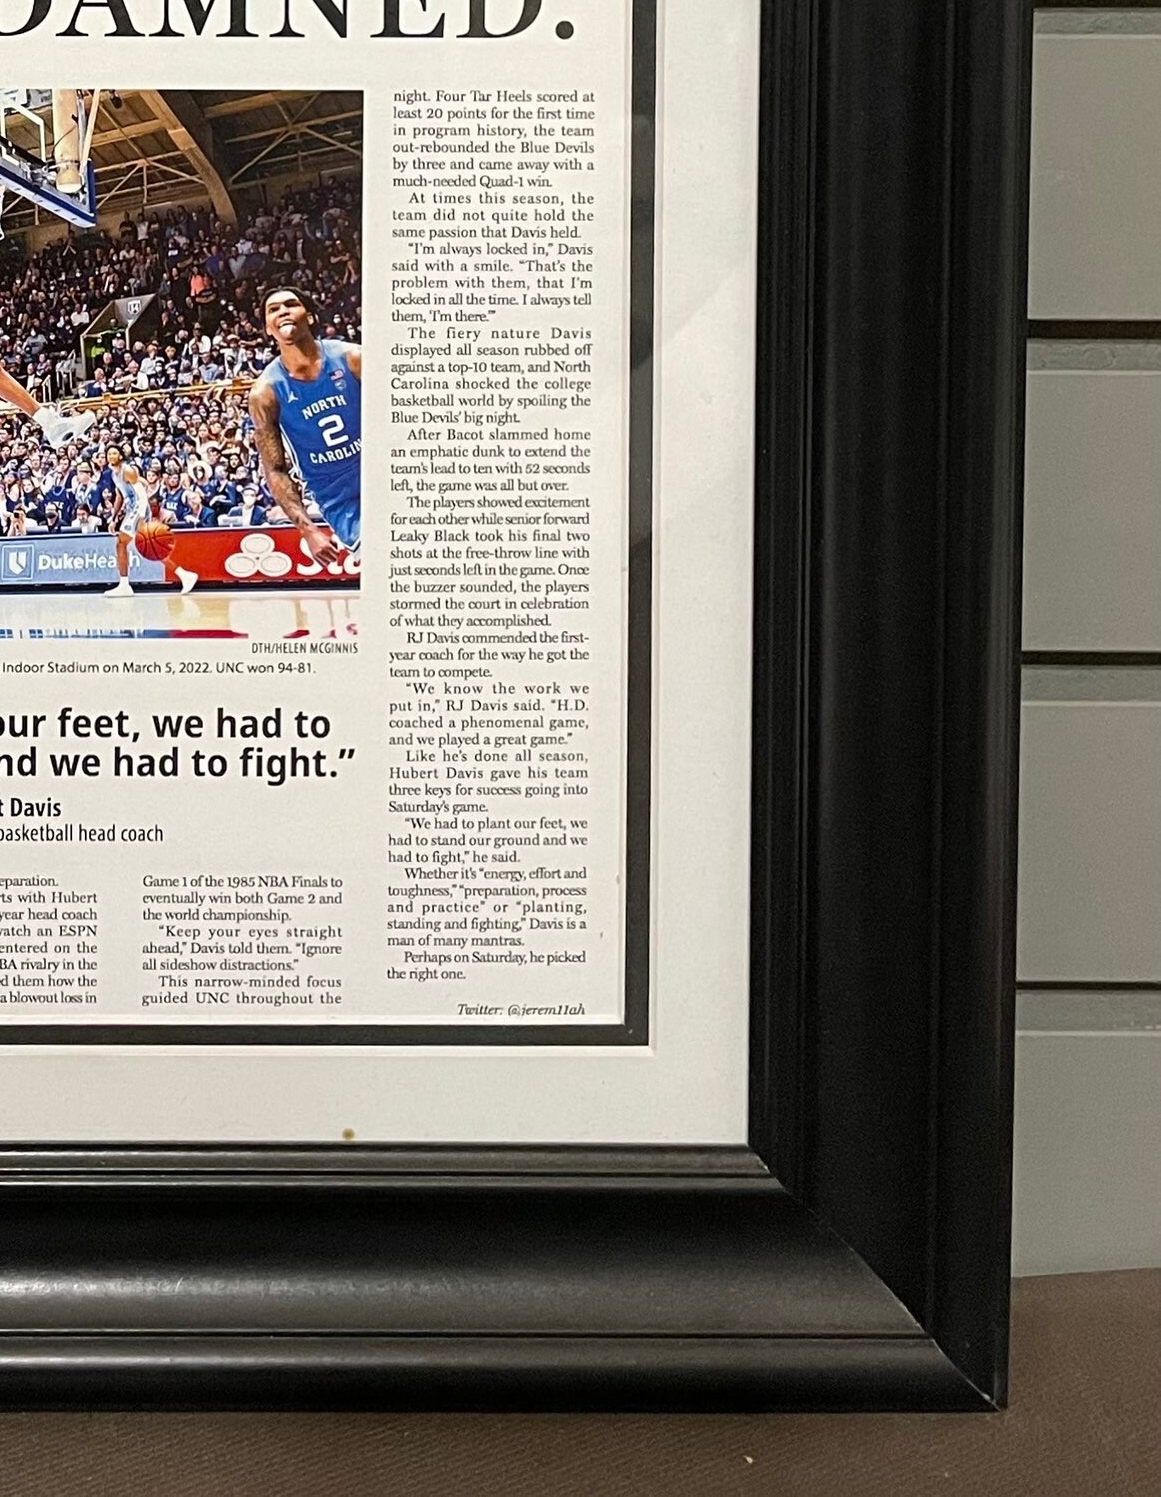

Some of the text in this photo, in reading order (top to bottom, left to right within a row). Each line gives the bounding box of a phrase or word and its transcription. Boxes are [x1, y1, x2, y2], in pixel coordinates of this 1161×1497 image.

[394, 123, 594, 139] in program history, the team
[408, 326, 591, 342] The fiery nature Davis
[391, 377, 591, 393] Carolina shocked the college
[302, 395, 347, 420] NORTH
[318, 414, 349, 447] 2
[391, 529, 590, 545] Leaky Black took his final two
[39, 550, 140, 571] DukeHeah
[252, 642, 358, 654] DTH/HELEN MCGINNIS
[2, 661, 45, 674] Indoor
[47, 661, 100, 674] Stadium
[103, 664, 119, 674] on
[123, 661, 162, 674] March
[165, 661, 176, 676] 5,
[179, 661, 213, 674] 2022.
[216, 661, 245, 674] UNC
[247, 664, 275, 674] won
[277, 661, 317, 674] 94-81.
[58, 708, 139, 742] feet,
[153, 716, 203, 737] we
[218, 708, 281, 738] had
[295, 712, 330, 738] to
[50, 755, 100, 776] we
[115, 747, 178, 776] had
[192, 751, 227, 776] to
[240, 747, 354, 786] fight.”
[389, 766, 588, 782] Hubert Davis gave his team
[11, 798, 61, 816] Davis
[79, 824, 115, 841] head
[121, 825, 163, 841] coach
[54, 945, 70, 954] on
[77, 941, 97, 954] the
[387, 967, 466, 982] the right one.
[142, 991, 342, 1007] guided UNC throughout the
